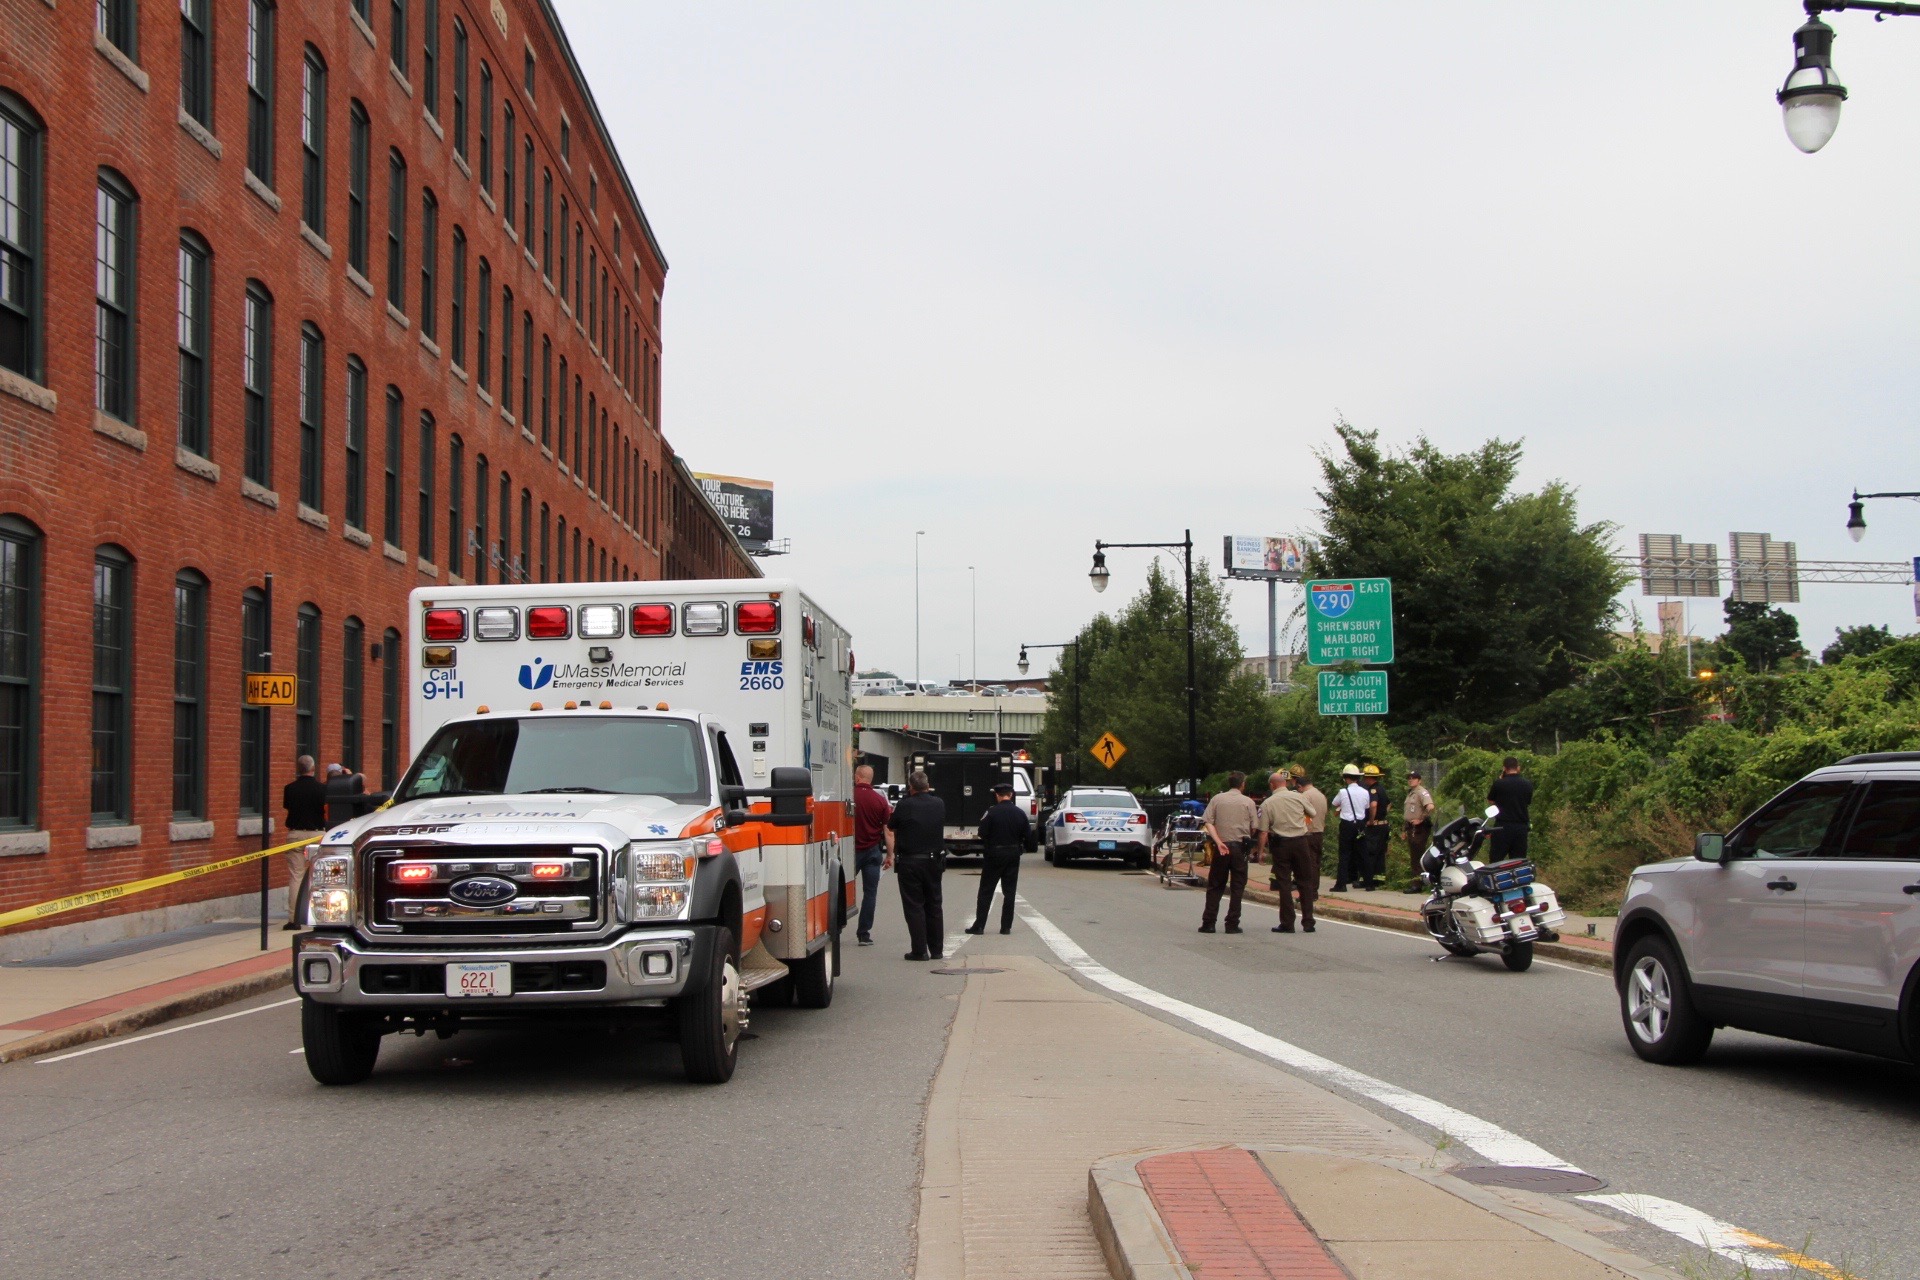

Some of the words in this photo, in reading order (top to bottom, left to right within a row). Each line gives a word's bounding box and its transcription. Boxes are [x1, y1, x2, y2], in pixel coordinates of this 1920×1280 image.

[701, 479, 721, 492] YOUR
[738, 525, 751, 536] 26
[1318, 594, 1350, 610] 290
[1360, 582, 1385, 593] EAST
[1317, 620, 1381, 632] SHREWSBURY
[1324, 633, 1376, 644] MARLBORO
[1321, 647, 1345, 657] NEXT
[1352, 645, 1380, 656] RIGHT
[429, 668, 457, 680] Call
[553, 662, 687, 679] UMassMemorial
[740, 661, 783, 675] EMS
[552, 680, 603, 690] Emergency
[606, 679, 642, 688] Medical
[644, 678, 684, 687] Services
[739, 676, 784, 690] 2660
[1324, 674, 1345, 687] 122
[1350, 675, 1382, 686] SOUTH
[248, 681, 292, 698] AHEAD
[422, 681, 464, 700] 9-1-1
[1329, 689, 1377, 700] UXBRIDGE
[1324, 703, 1347, 713] NEXT
[1355, 702, 1383, 712] RIGHT
[396, 825, 489, 835] SUPER
[505, 824, 576, 833] DUTY
[101, 887, 124, 899] POLICE
[463, 881, 501, 897] Ford
[75, 896, 84, 906] DO
[86, 892, 100, 904] LINE
[36, 902, 58, 916] CROSS
[60, 899, 73, 910] NOT
[460, 972, 494, 988] 6221
